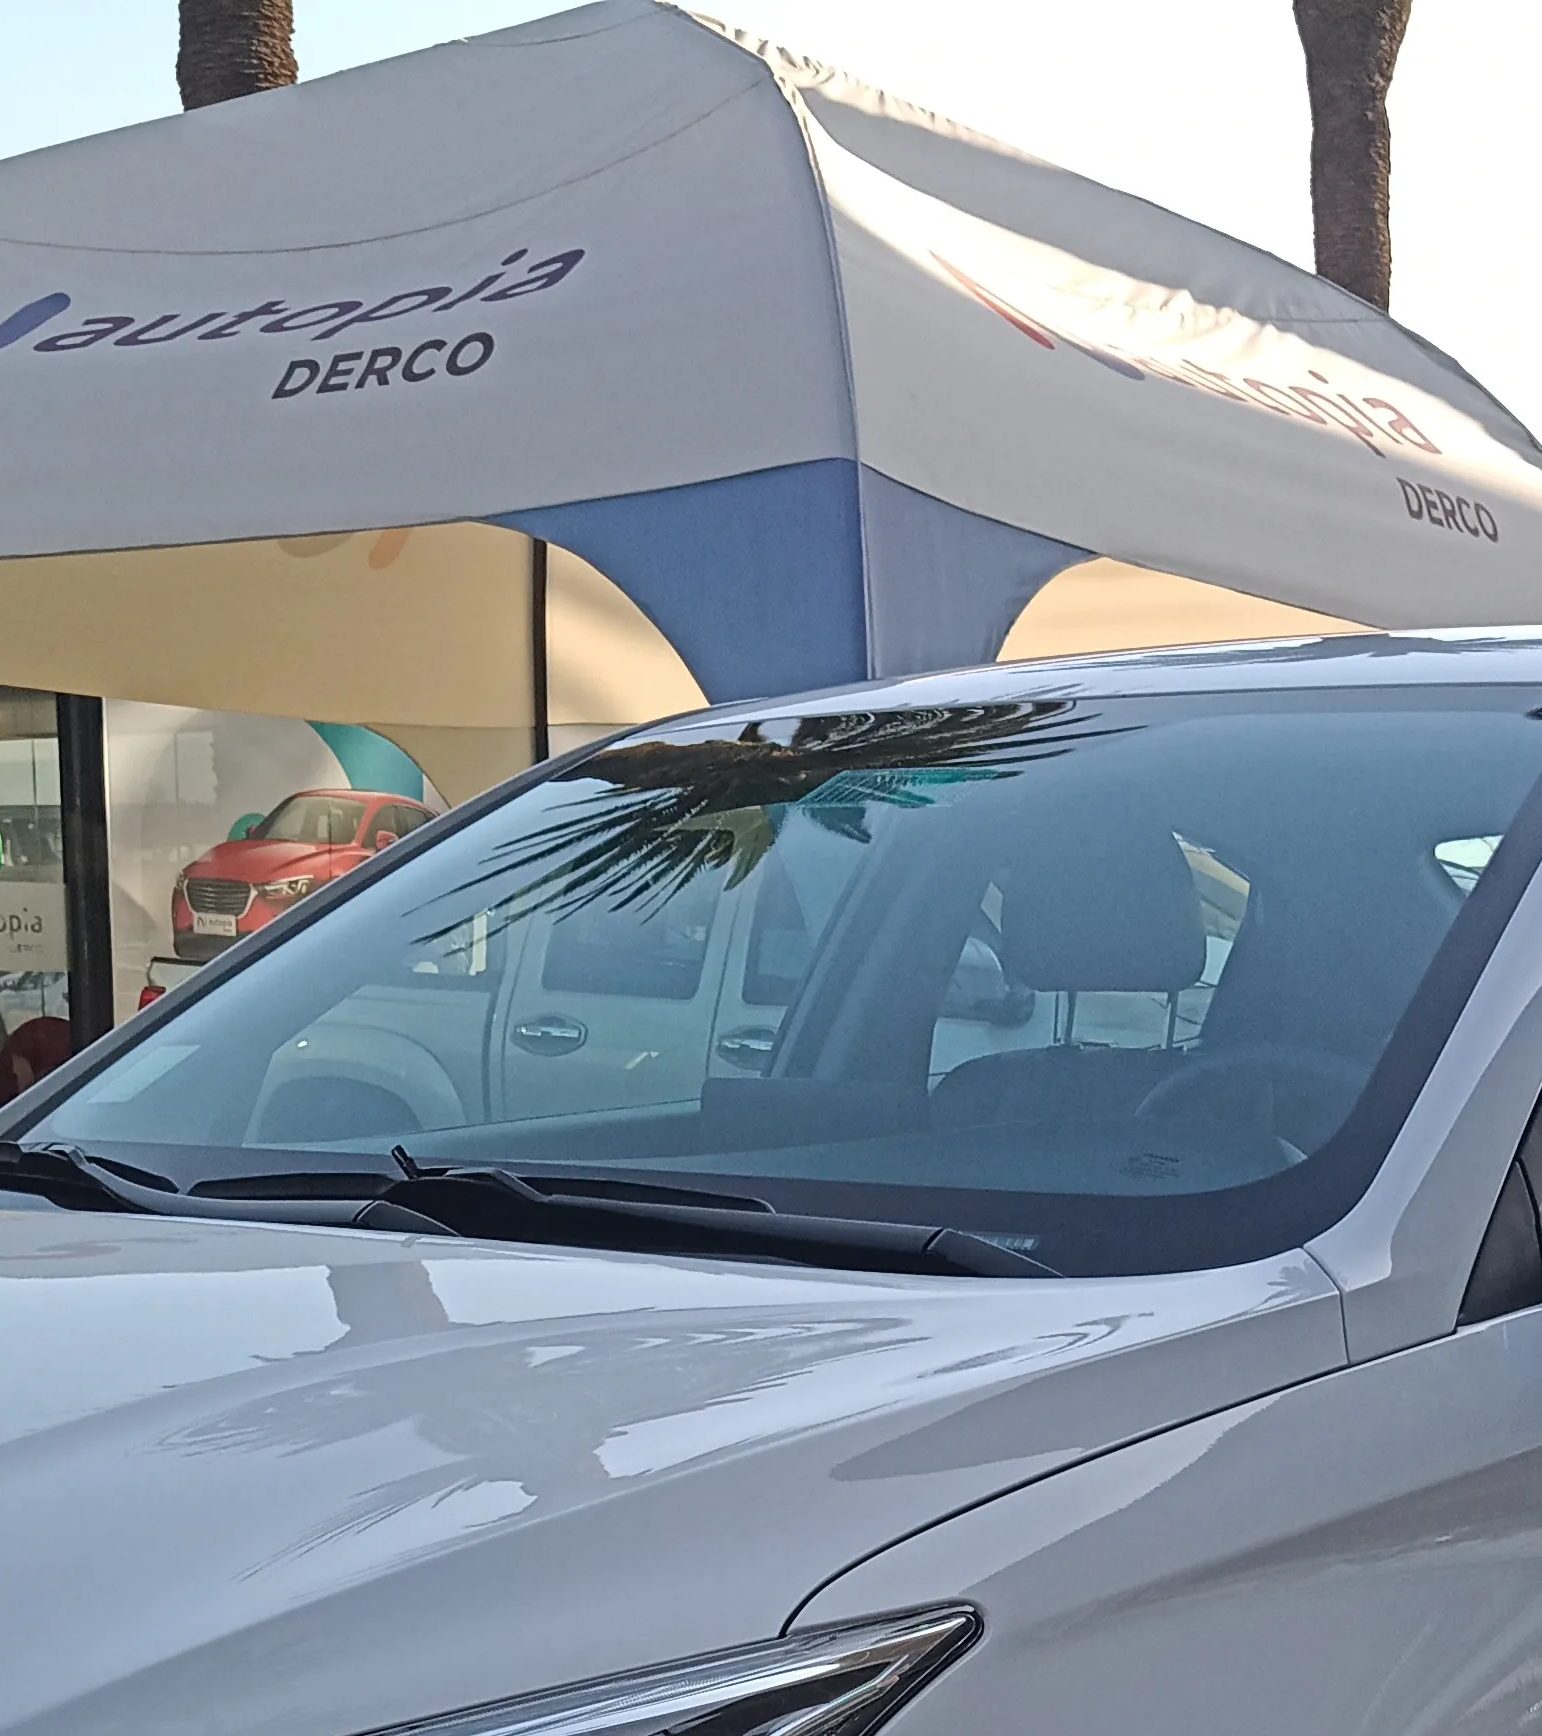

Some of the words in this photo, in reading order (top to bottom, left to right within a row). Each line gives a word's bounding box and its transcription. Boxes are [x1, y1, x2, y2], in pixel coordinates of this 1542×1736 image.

[32, 248, 586, 353] autopia
[271, 331, 496, 400] DERCO
[1395, 477, 1500, 544] DERCO
